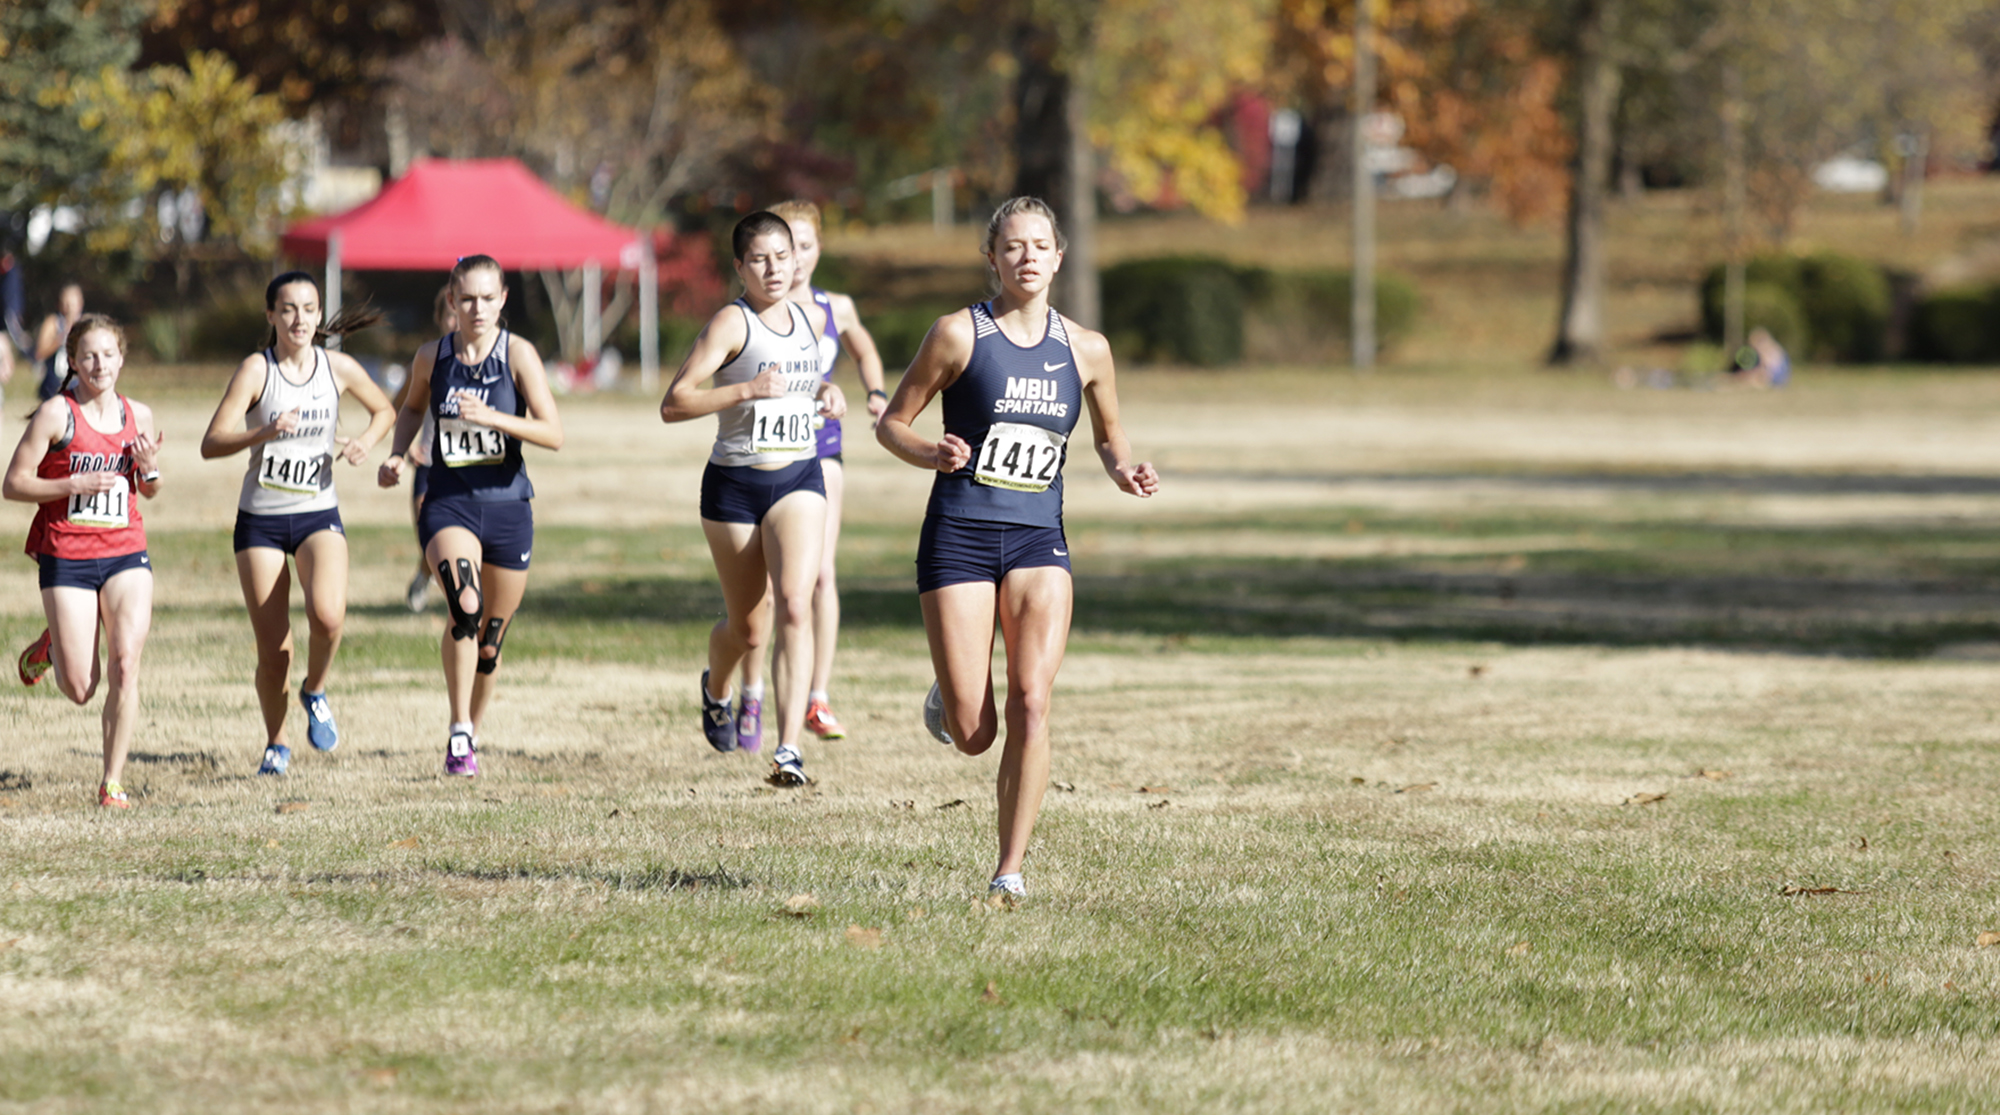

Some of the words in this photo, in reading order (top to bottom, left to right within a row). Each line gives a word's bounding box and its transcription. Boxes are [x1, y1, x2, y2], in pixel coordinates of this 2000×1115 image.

[1004, 376, 1058, 401] MBU
[269, 408, 330, 423] CMBIA
[994, 399, 1068, 418] SPARTANS
[757, 413, 810, 442] 1403
[444, 430, 503, 456] 1413
[263, 455, 321, 486] 1402
[982, 437, 1057, 481] 1412
[71, 489, 123, 517] 1411
